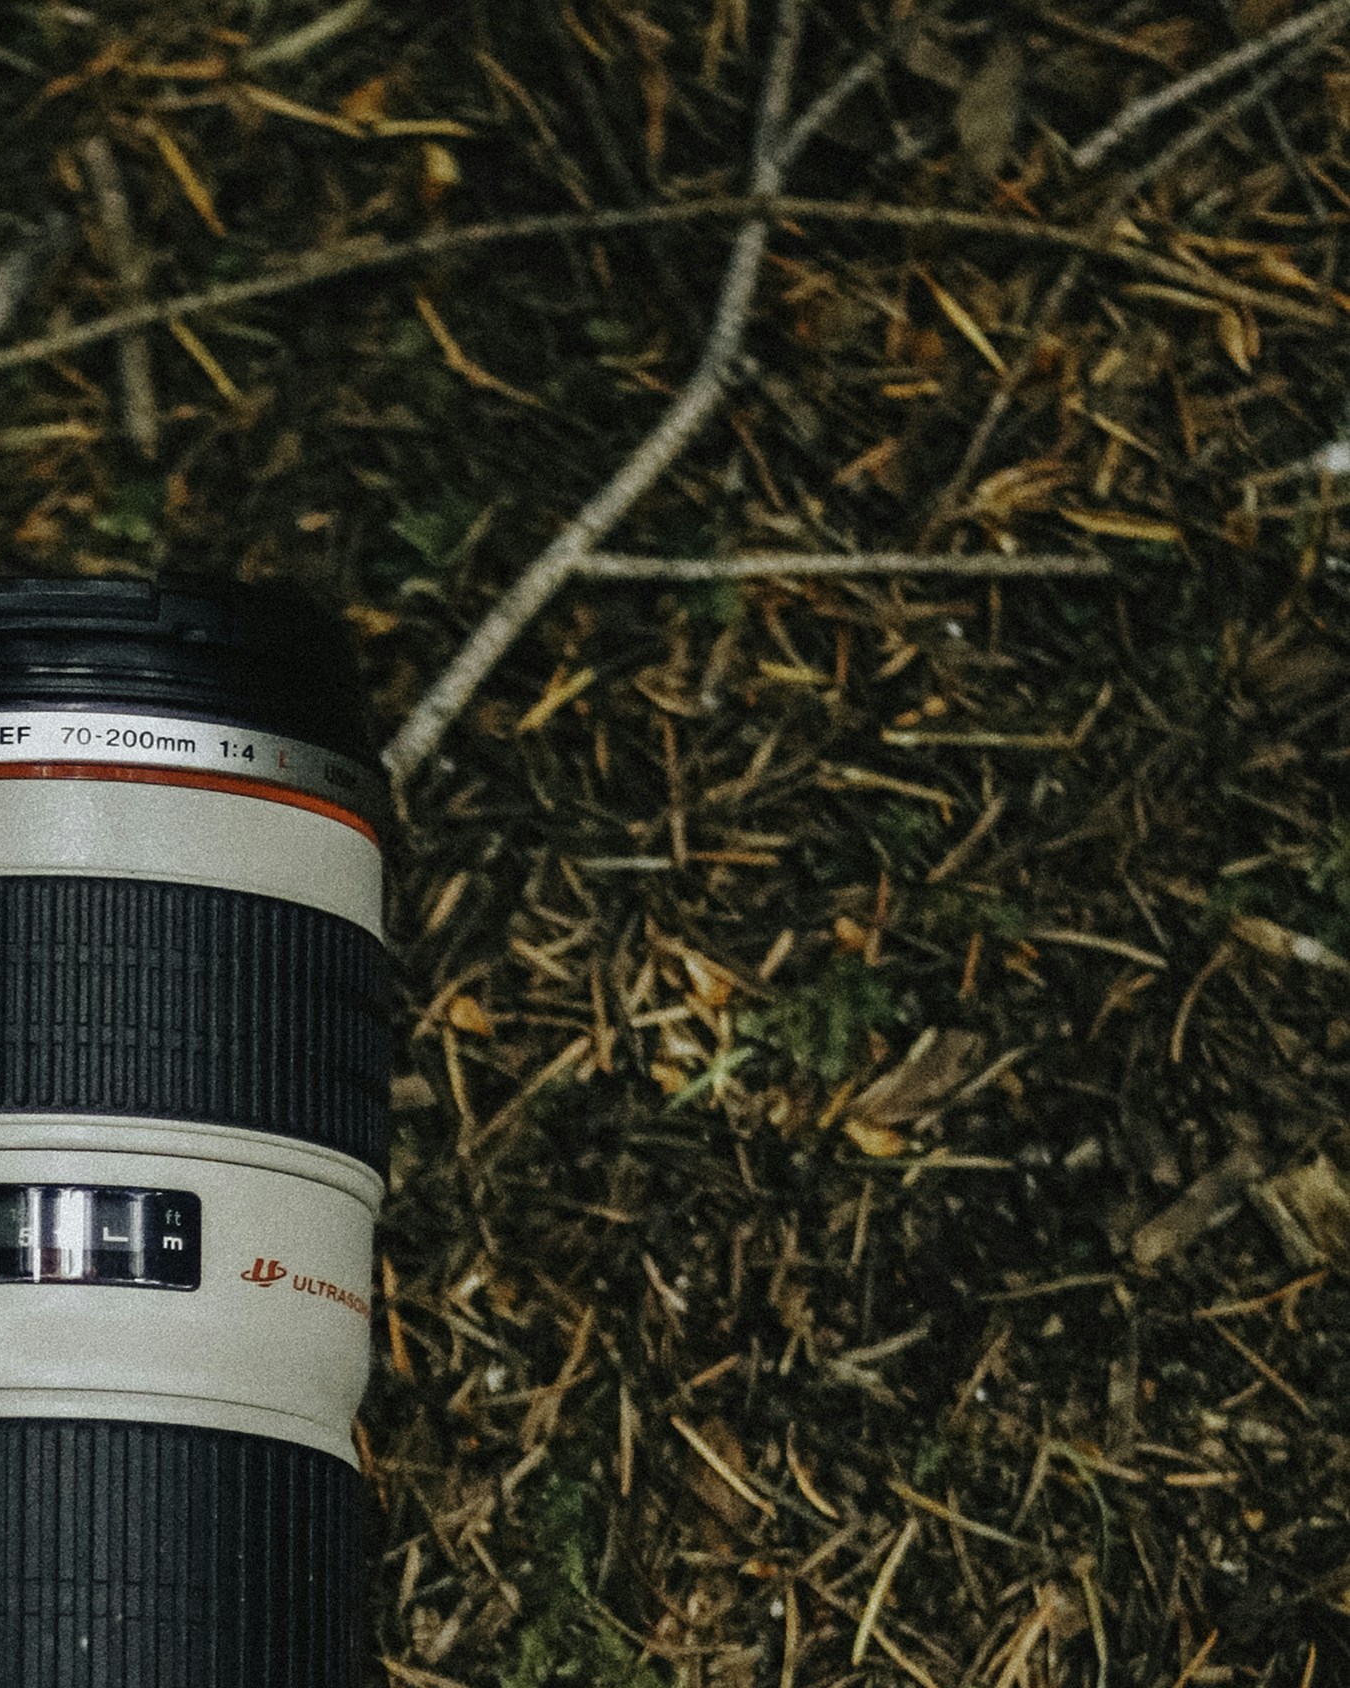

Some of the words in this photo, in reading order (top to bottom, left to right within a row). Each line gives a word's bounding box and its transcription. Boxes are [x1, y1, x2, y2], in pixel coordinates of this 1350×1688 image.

[0, 726, 32, 745] EF
[60, 727, 196, 753] 70-200mm
[219, 741, 255, 762] 1:4
[165, 1209, 182, 1226] ft
[18, 1227, 34, 1248] 5
[162, 1236, 183, 1250] m
